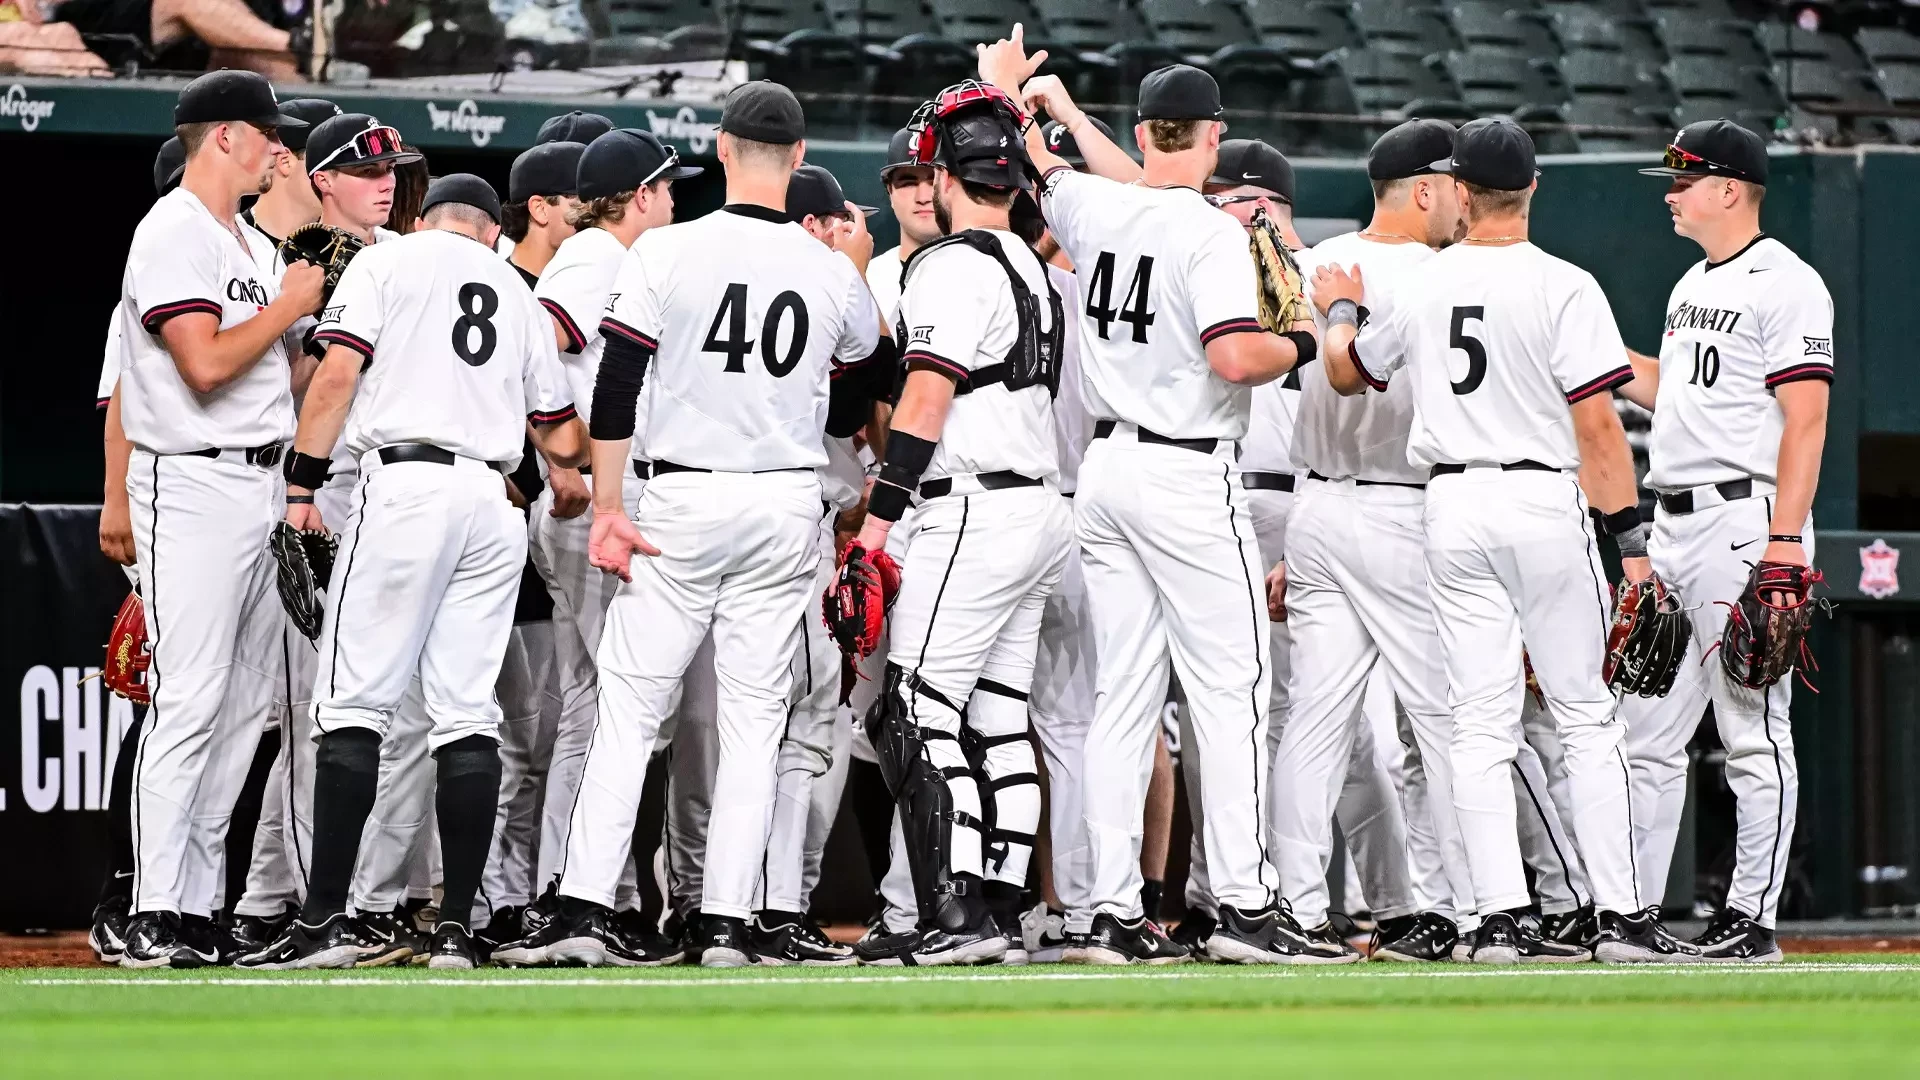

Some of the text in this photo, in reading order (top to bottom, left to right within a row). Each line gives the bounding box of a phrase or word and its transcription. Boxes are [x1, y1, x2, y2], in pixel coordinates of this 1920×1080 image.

[0, 84, 55, 132] Kroger
[451, 282, 499, 367] 8
[701, 282, 809, 378] 40
[1086, 250, 1156, 344] 44
[1449, 305, 1487, 395] 5
[1688, 341, 1720, 389] 10
